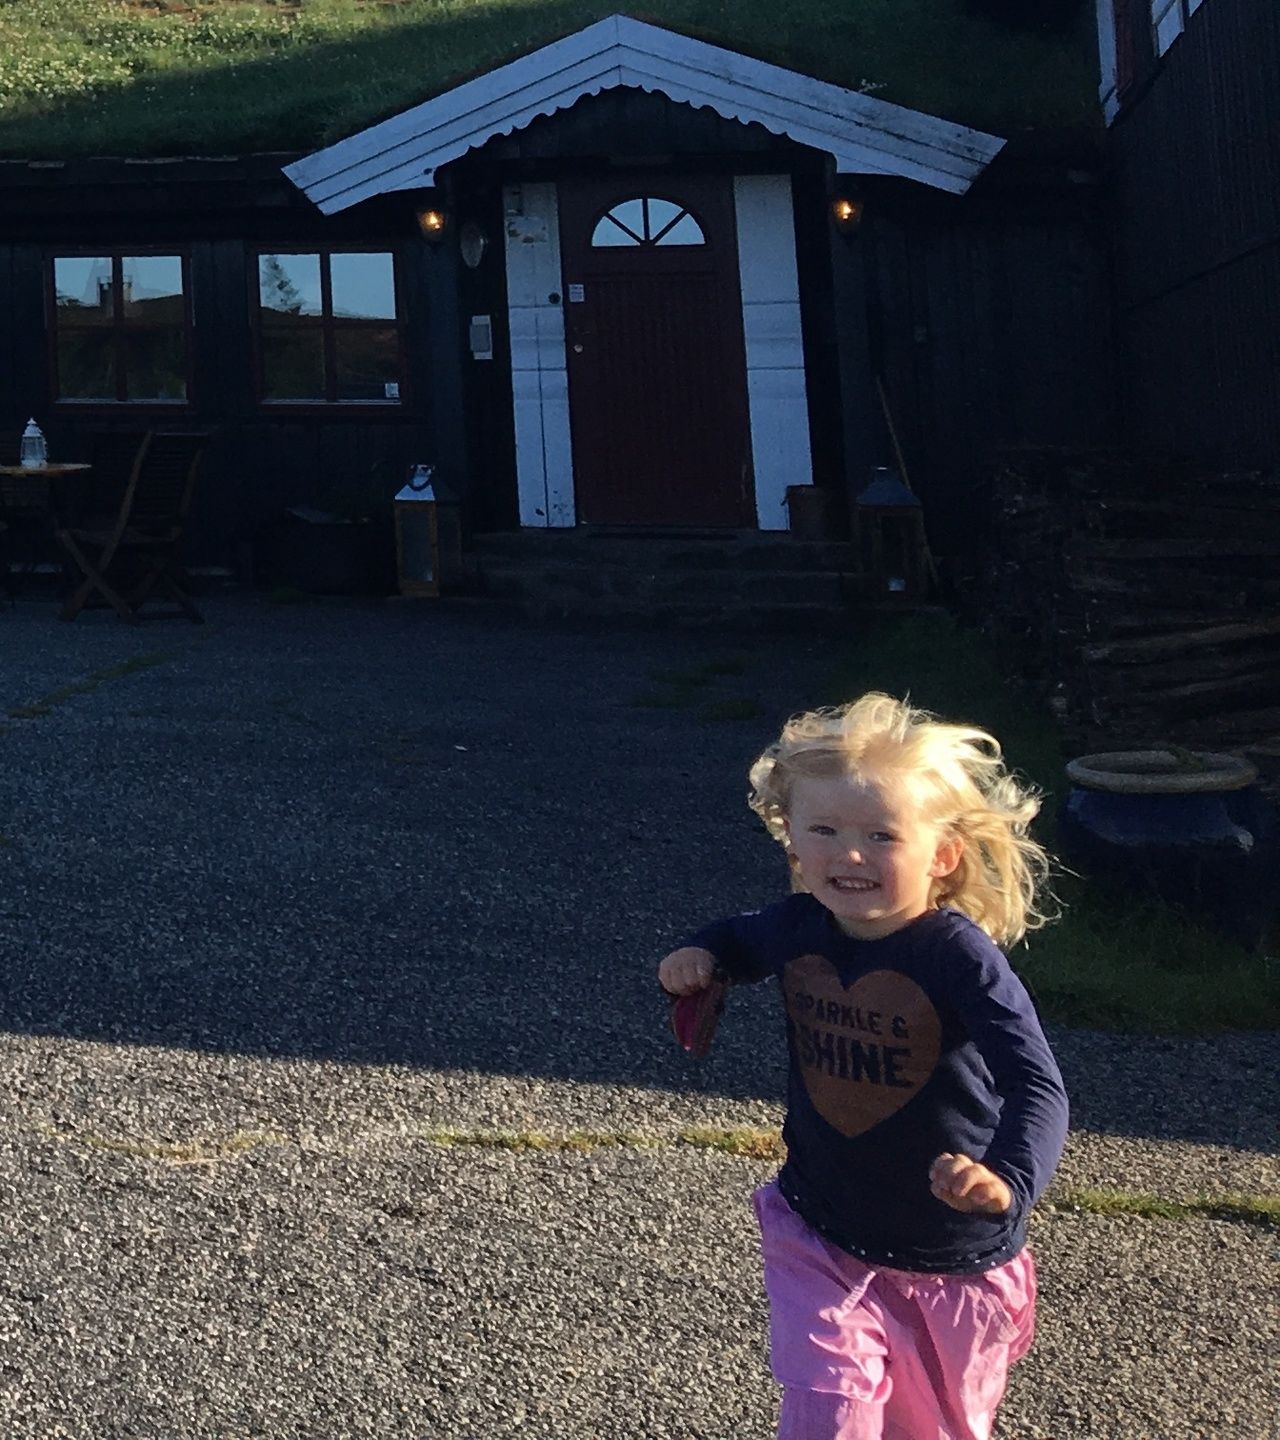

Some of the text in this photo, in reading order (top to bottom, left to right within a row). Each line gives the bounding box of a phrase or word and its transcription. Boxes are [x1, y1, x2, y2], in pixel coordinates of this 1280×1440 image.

[794, 991, 910, 1040] SPARKLE &
[797, 1023, 915, 1089] SHINE
